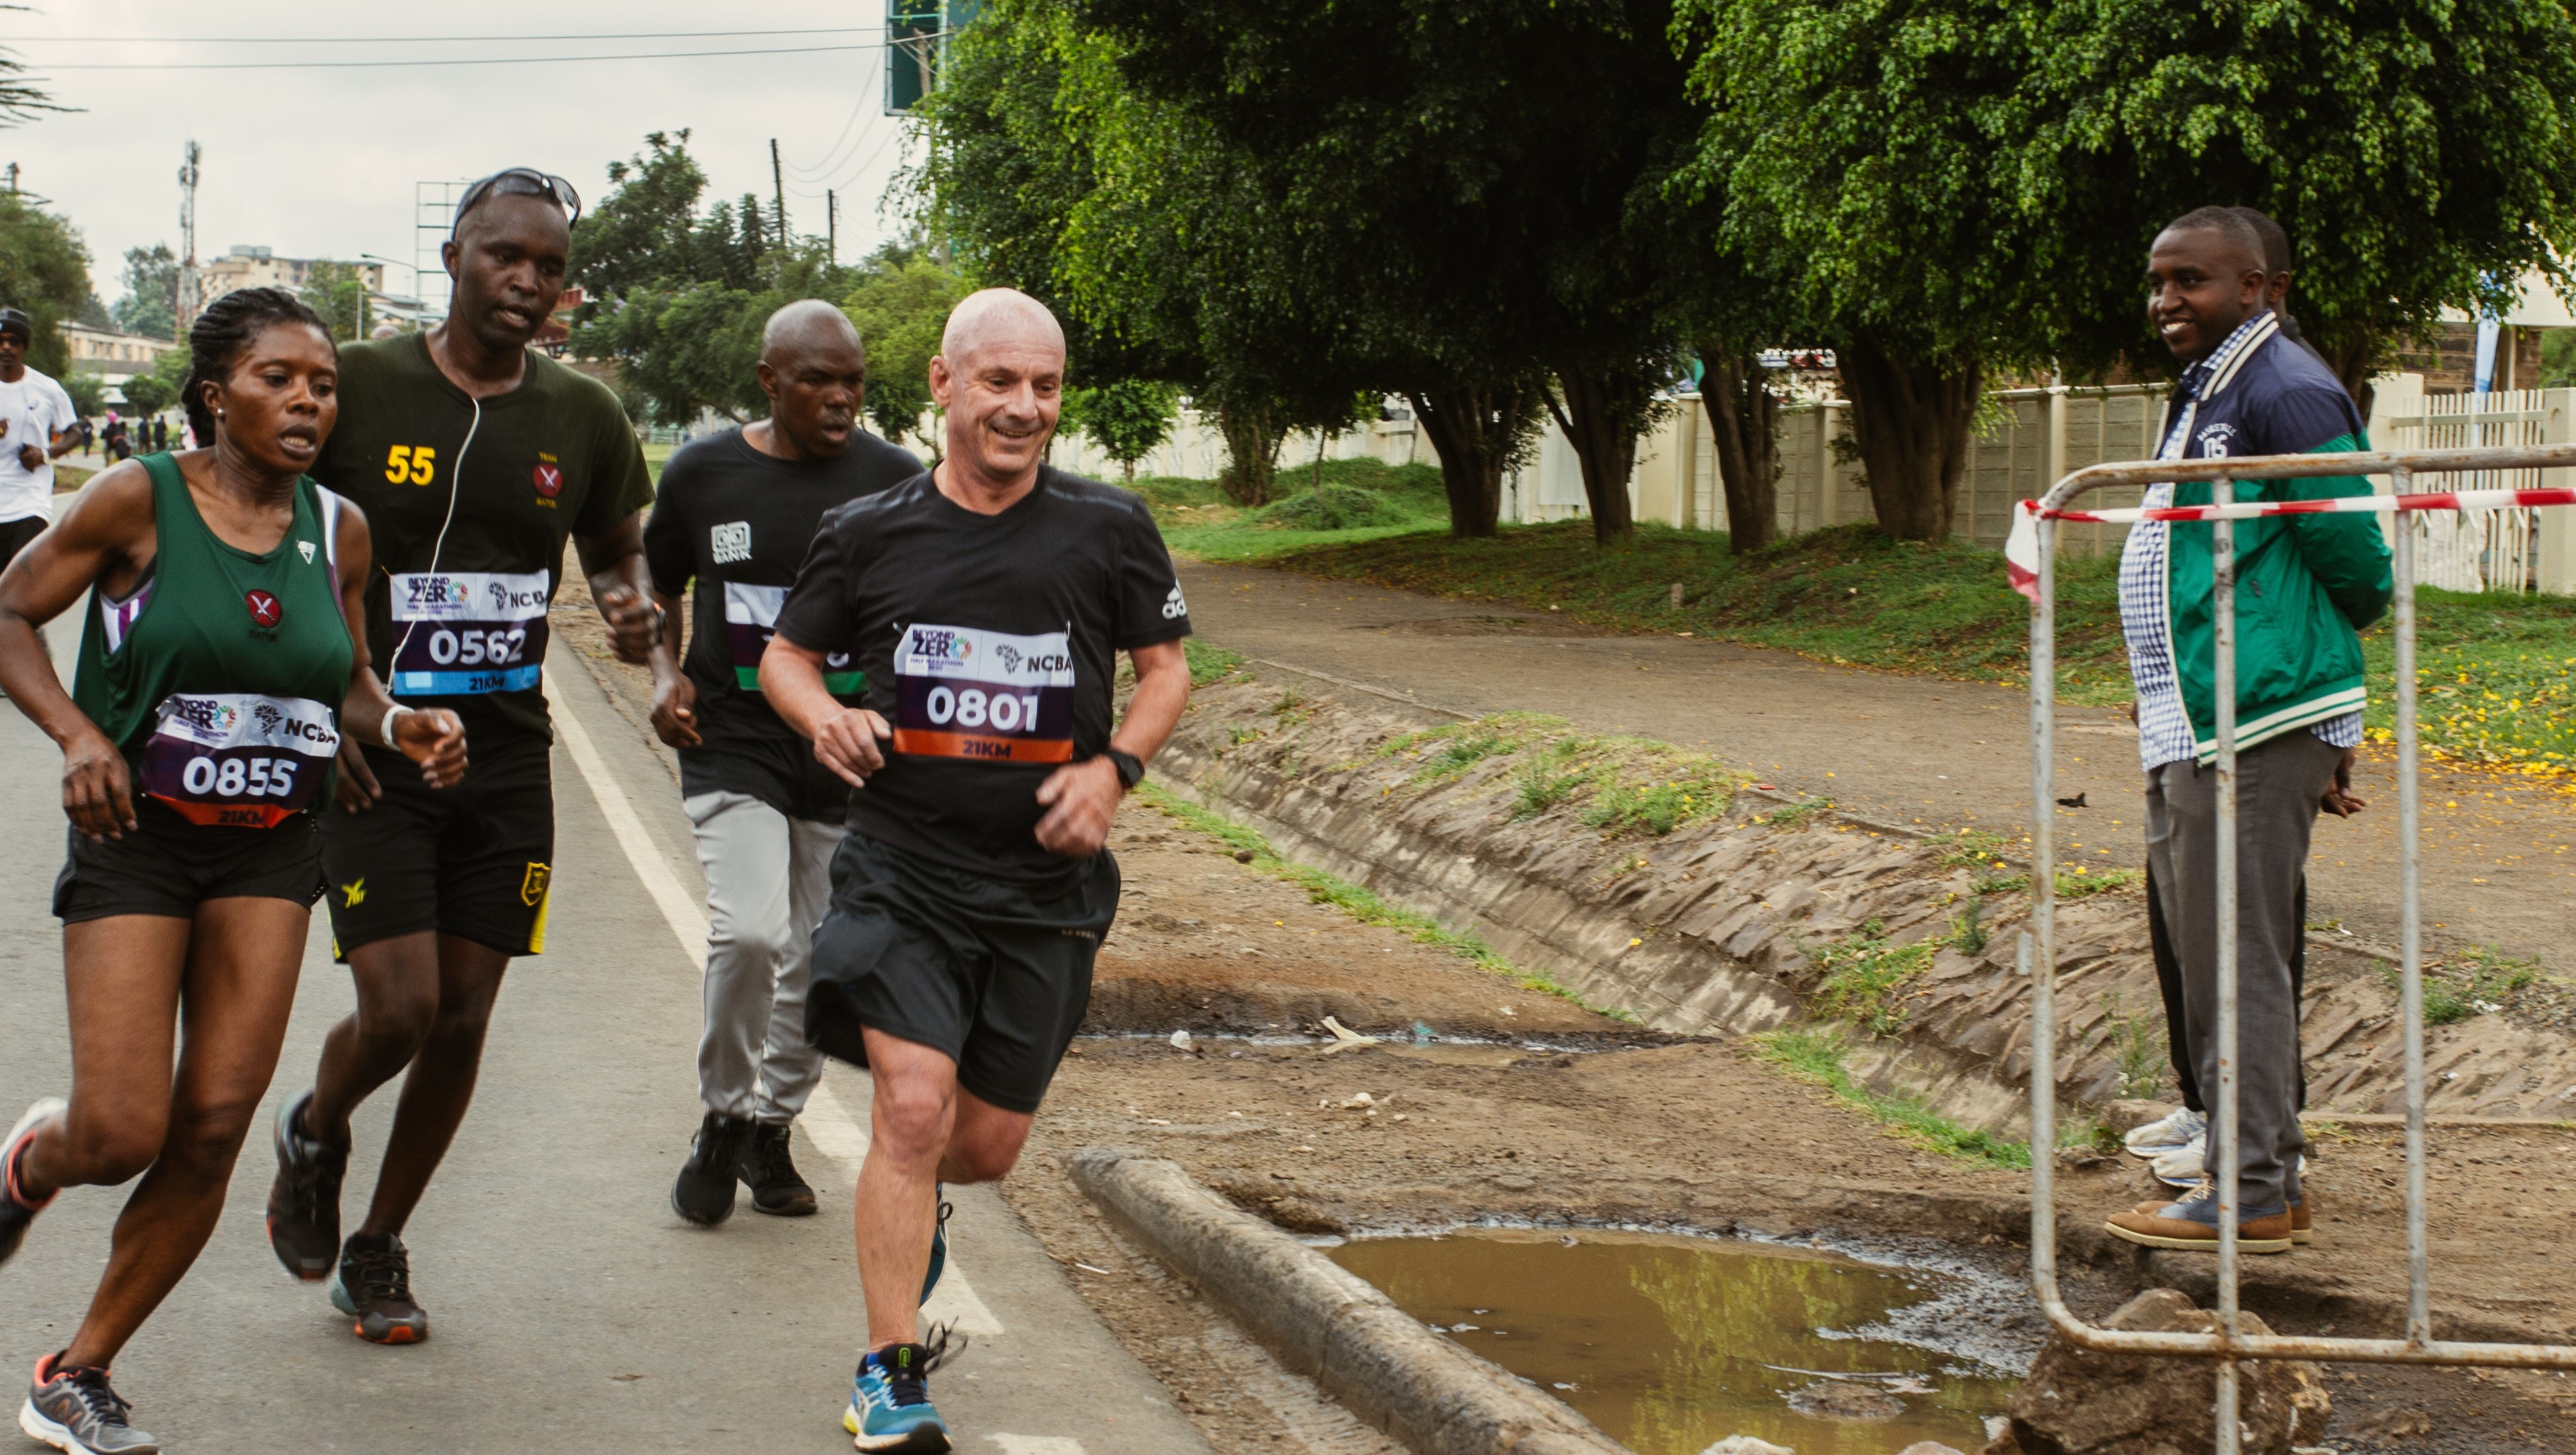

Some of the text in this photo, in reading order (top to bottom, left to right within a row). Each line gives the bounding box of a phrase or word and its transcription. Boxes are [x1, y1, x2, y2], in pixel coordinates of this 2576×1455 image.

[385, 444, 436, 486] 55
[408, 577, 450, 587] BEYOND
[913, 629, 955, 641] BEYOND
[430, 628, 526, 665] 0562
[1027, 655, 1072, 674] NCBA
[469, 676, 505, 691] 21KM
[927, 686, 1038, 732] 0801
[963, 739, 1012, 758] 21KM
[183, 756, 298, 797] 0855
[218, 810, 264, 824] 21KM
